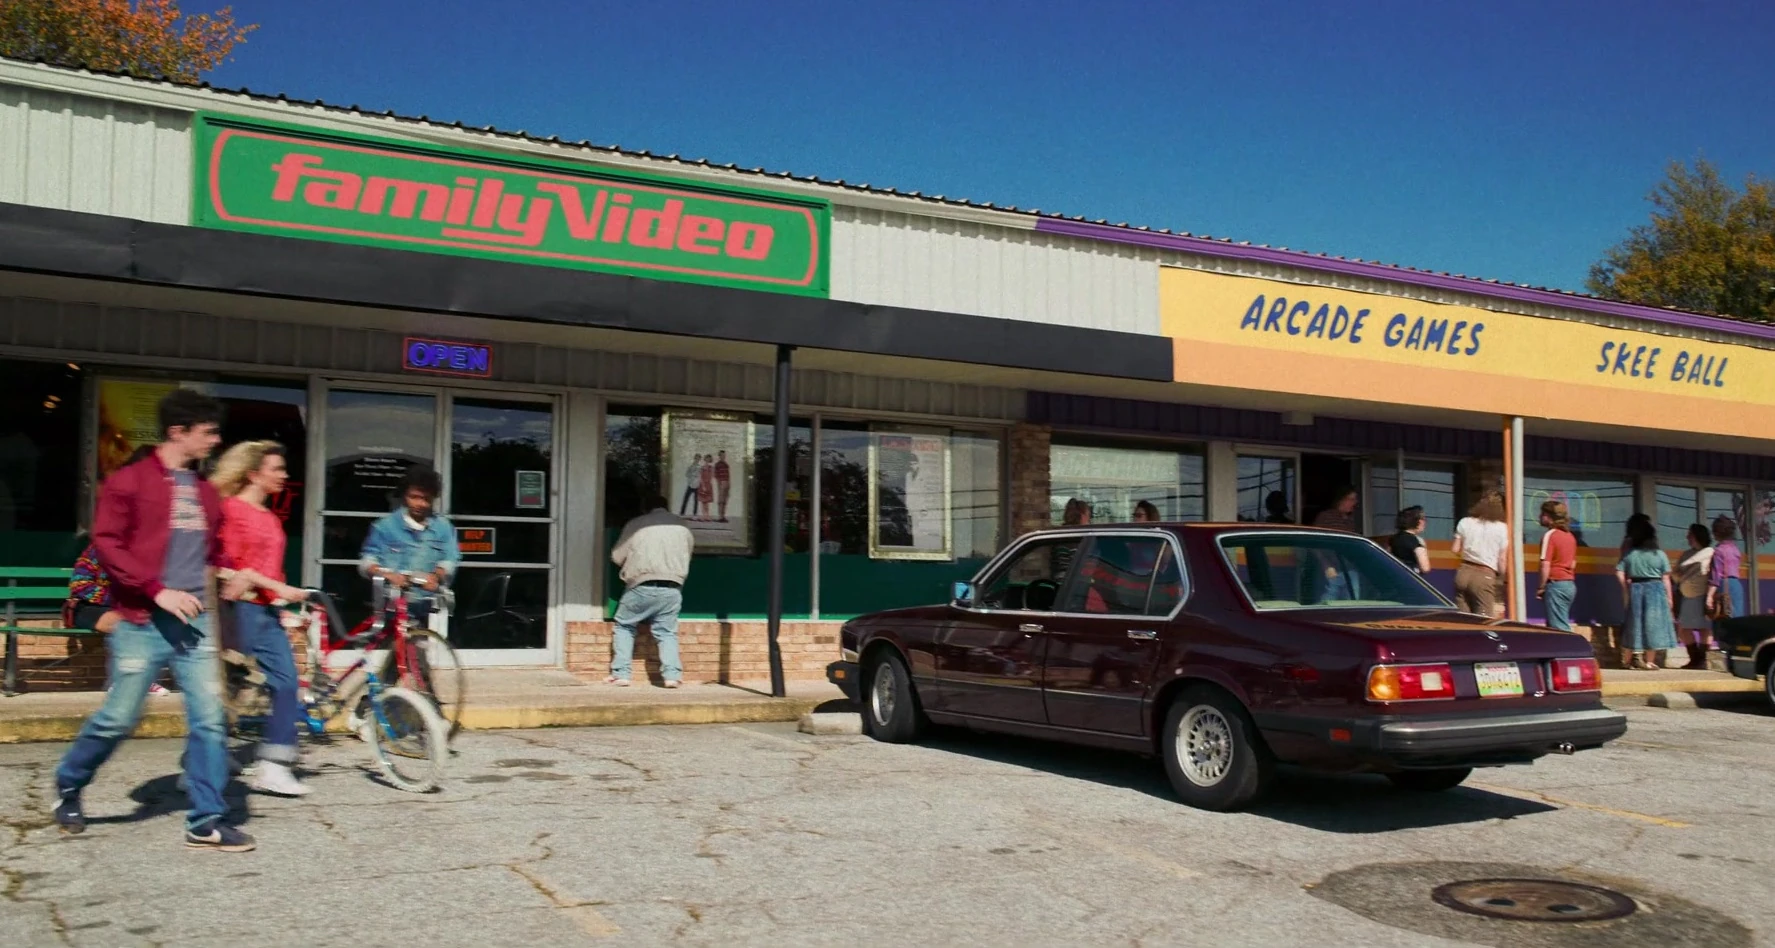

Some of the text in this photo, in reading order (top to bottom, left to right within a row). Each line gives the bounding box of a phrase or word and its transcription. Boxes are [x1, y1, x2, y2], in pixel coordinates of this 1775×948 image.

[1240, 294, 1485, 356] ARCADE GAMES
[408, 342, 488, 371] OPEN
[1596, 341, 1728, 387] SKEE BALL
